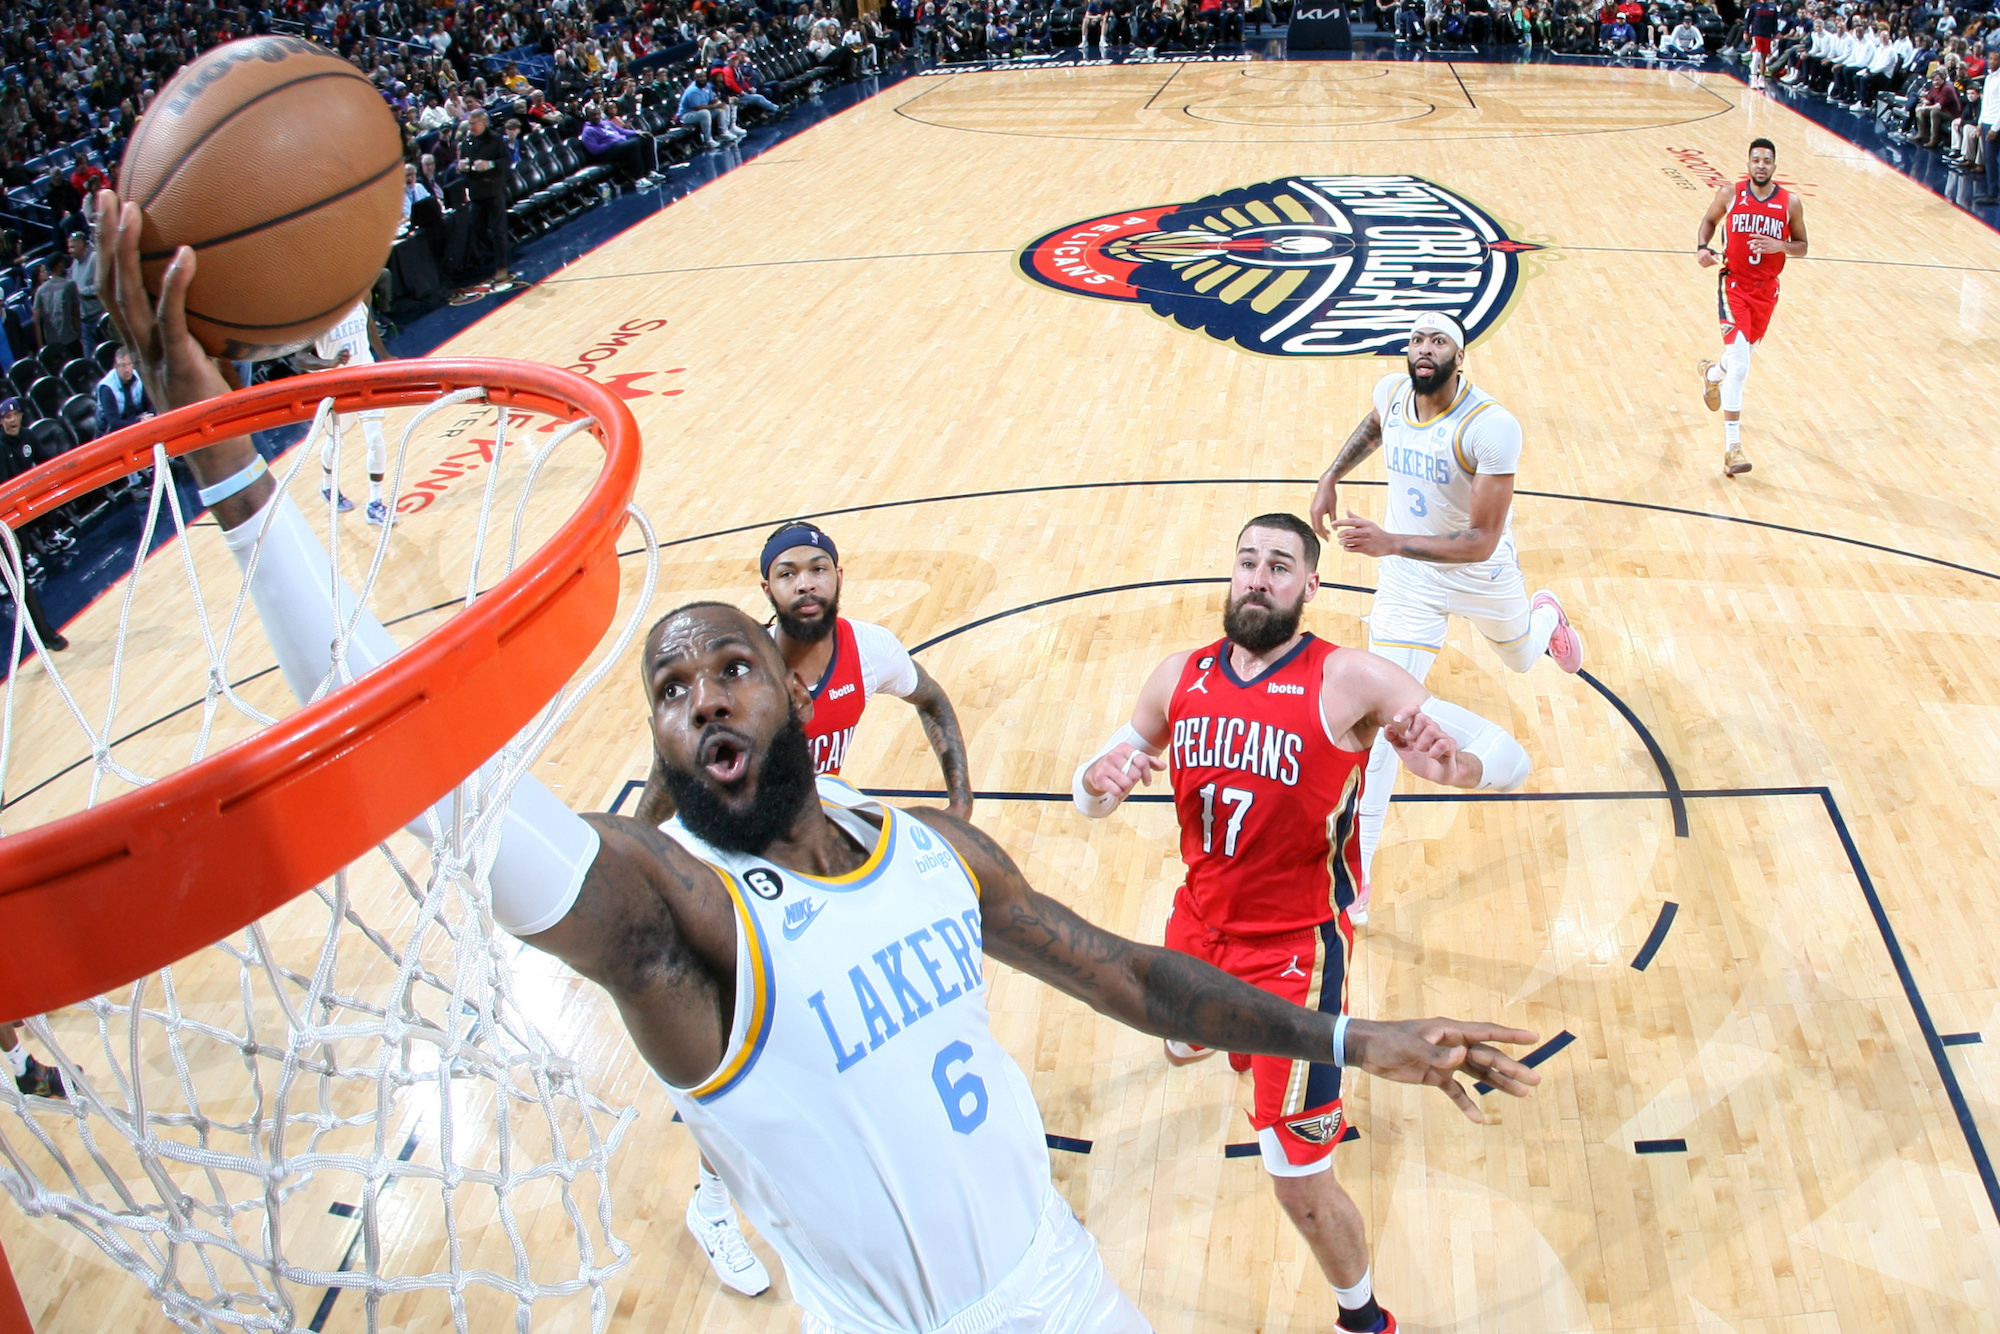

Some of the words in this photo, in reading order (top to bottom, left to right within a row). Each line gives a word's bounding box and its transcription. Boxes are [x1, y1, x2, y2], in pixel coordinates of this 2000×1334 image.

[1297, 8, 1340, 20] KIA
[919, 65, 987, 76] NEW
[1300, 175, 1461, 220] NEW
[1731, 213, 1785, 240] PELICANS
[1052, 216, 1147, 285] PELICANS
[1385, 444, 1450, 485] LAKERS
[1407, 487, 1427, 518] 3
[1199, 657, 1214, 670] 6
[828, 683, 856, 700] ibotta
[1267, 682, 1305, 695] ibotta
[1173, 716, 1303, 786] PELICANS
[1199, 782, 1255, 857] 17
[914, 850, 952, 874] bibigo
[748, 871, 778, 899] 6
[784, 896, 814, 925] NIKE
[931, 1039, 990, 1135] 6
